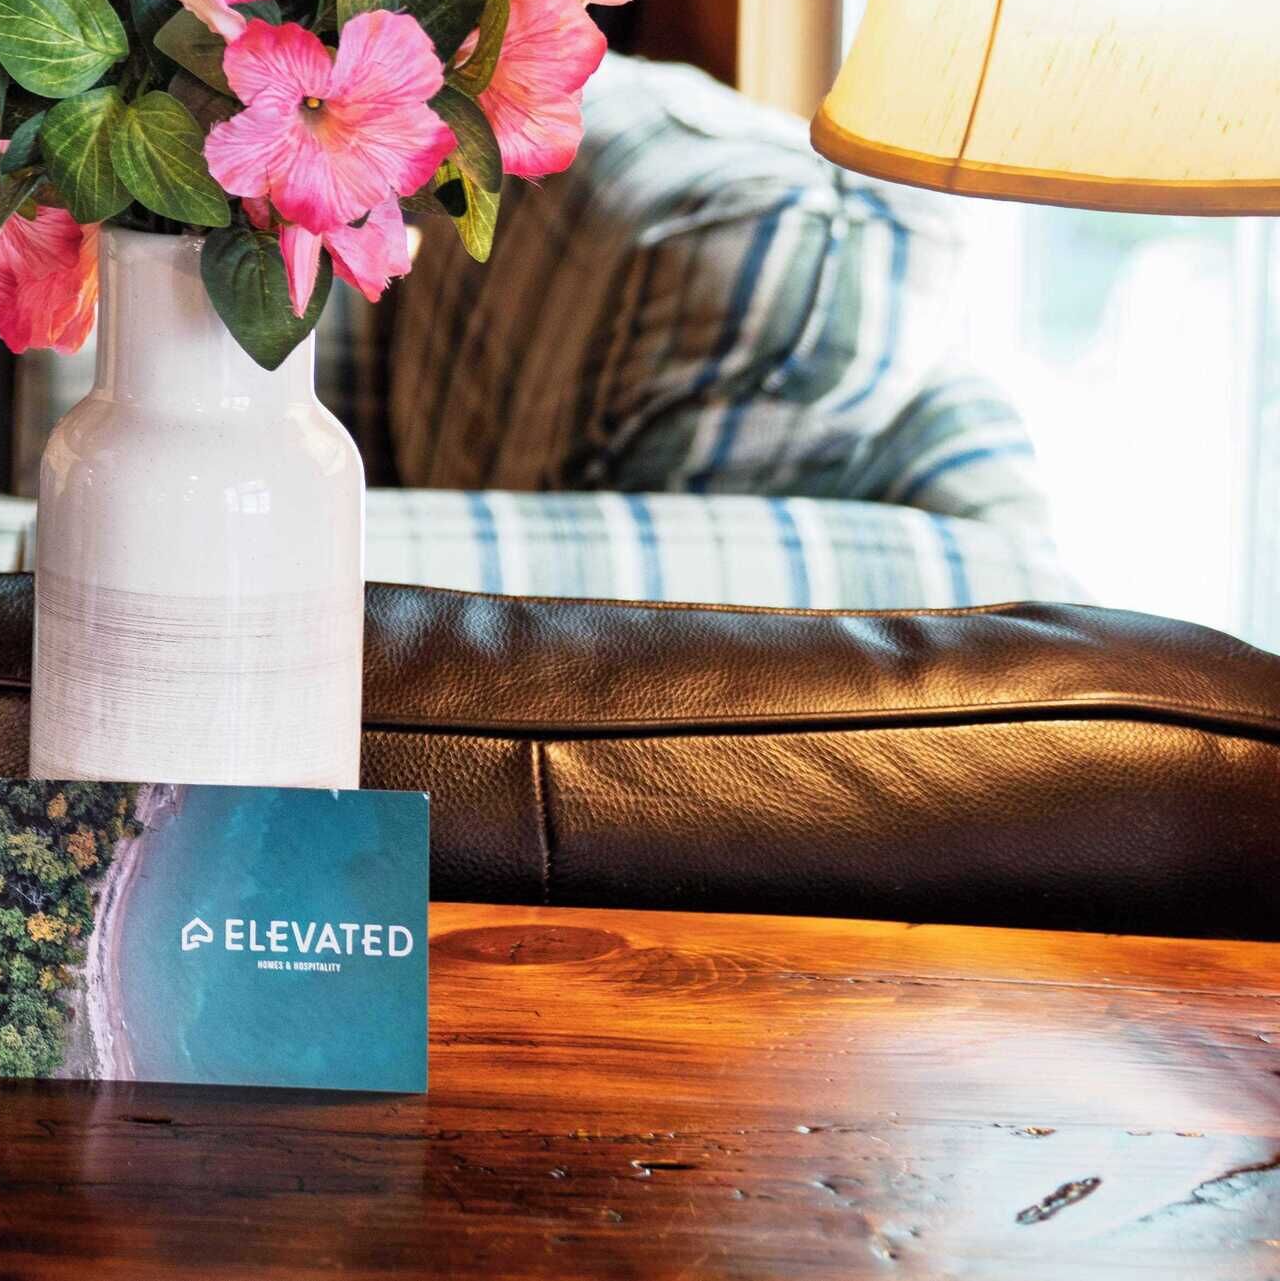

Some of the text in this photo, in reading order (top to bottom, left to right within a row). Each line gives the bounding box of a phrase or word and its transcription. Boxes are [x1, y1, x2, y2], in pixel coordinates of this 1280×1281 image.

[224, 918, 414, 957] ELEVATED
[257, 960, 340, 972] HOMES & HOSPITALITY
